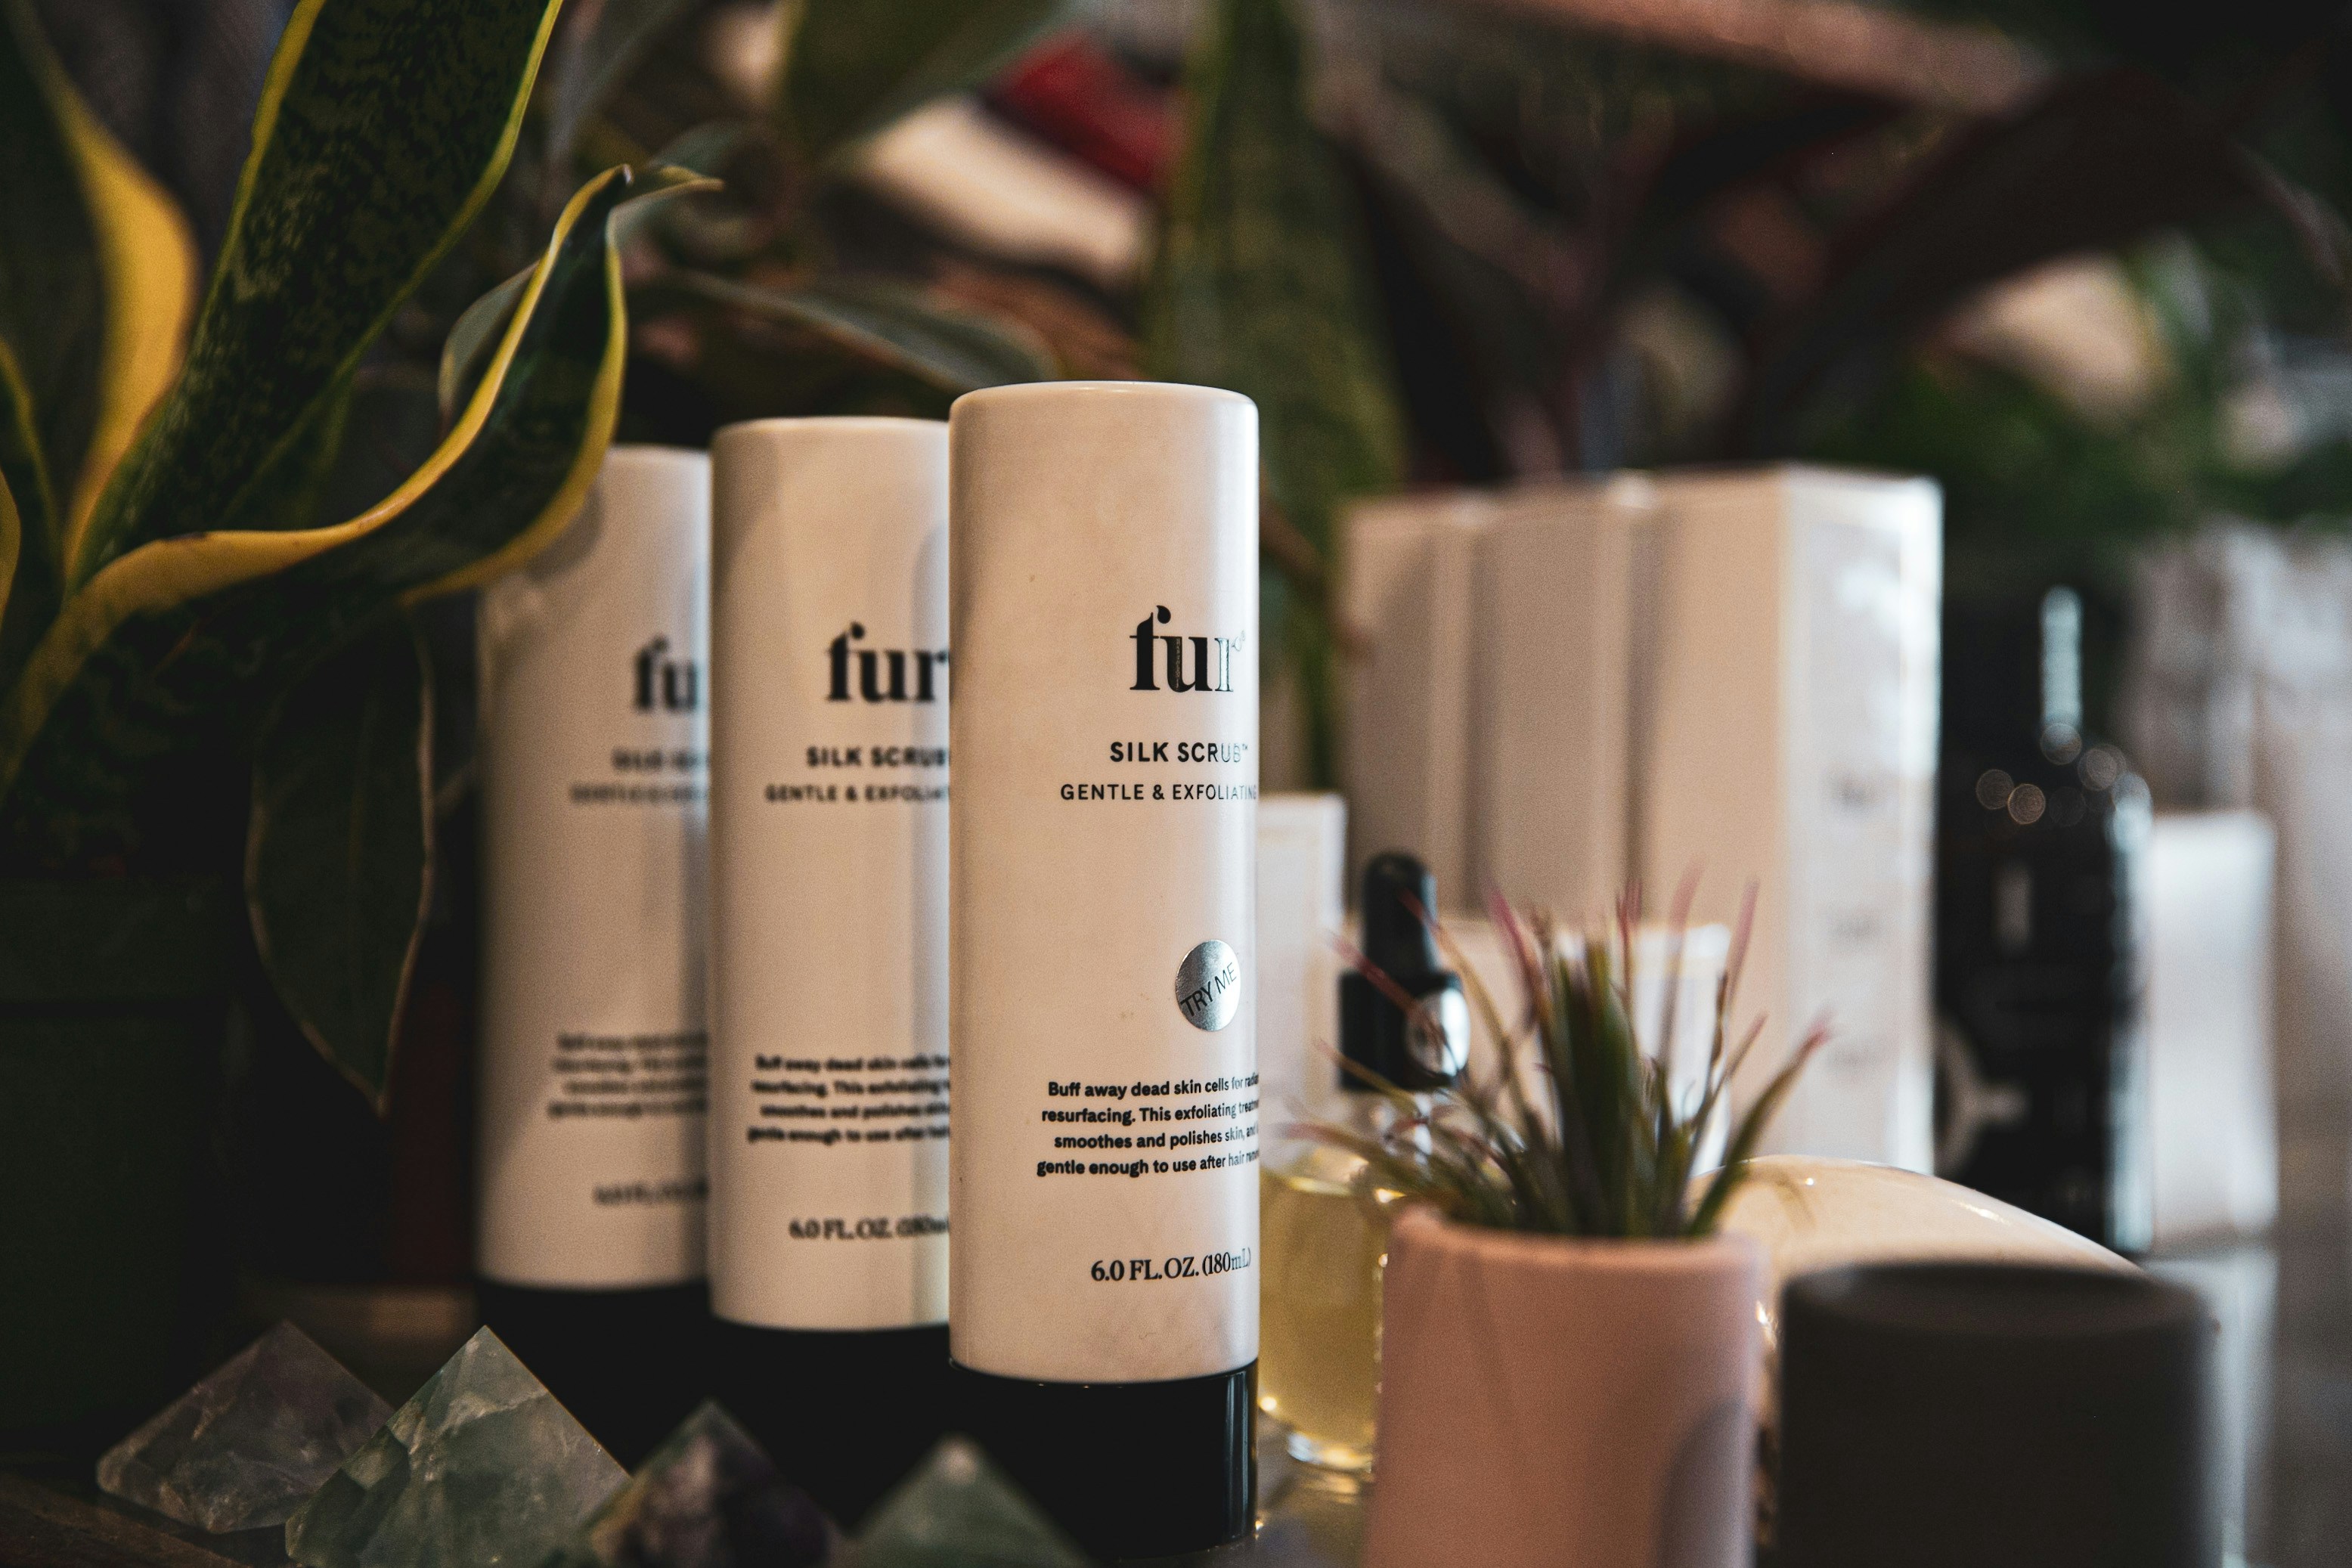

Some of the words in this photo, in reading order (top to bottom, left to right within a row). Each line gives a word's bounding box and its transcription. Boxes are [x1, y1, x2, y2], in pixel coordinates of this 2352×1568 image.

[632, 636, 699, 713] fu
[826, 621, 949, 704] fur
[807, 746, 861, 767] SILK
[1110, 741, 1170, 762] SILK
[1060, 783, 1145, 801] GENTLE
[1151, 784, 1166, 801] &
[1173, 783, 1258, 801] EXFOLIATING
[1179, 981, 1213, 1017] TRY
[1213, 962, 1238, 994] ME
[1048, 1081, 1081, 1097] Buff
[1084, 1084, 1127, 1100] away
[1131, 1080, 1170, 1096] dead
[1174, 1079, 1202, 1095] skin
[1204, 1077, 1229, 1092] cells
[1232, 1077, 1244, 1090] for
[1042, 1108, 1136, 1126] resurfacing.
[1139, 1106, 1171, 1122] This
[1174, 1103, 1237, 1121] exfoliating
[1054, 1134, 1133, 1149] smoothes
[1136, 1133, 1166, 1148] and
[1170, 1130, 1222, 1151] polishes
[1225, 1126, 1245, 1142] skin,
[1037, 1160, 1085, 1177] gentle
[1089, 1160, 1148, 1178] enough
[1153, 1159, 1169, 1174] to
[1173, 1158, 1197, 1173] use
[1200, 1155, 1226, 1170] after
[1229, 1151, 1244, 1167] hair
[1090, 1260, 1125, 1281] 6.0
[1202, 1247, 1251, 1276] (180mL)
